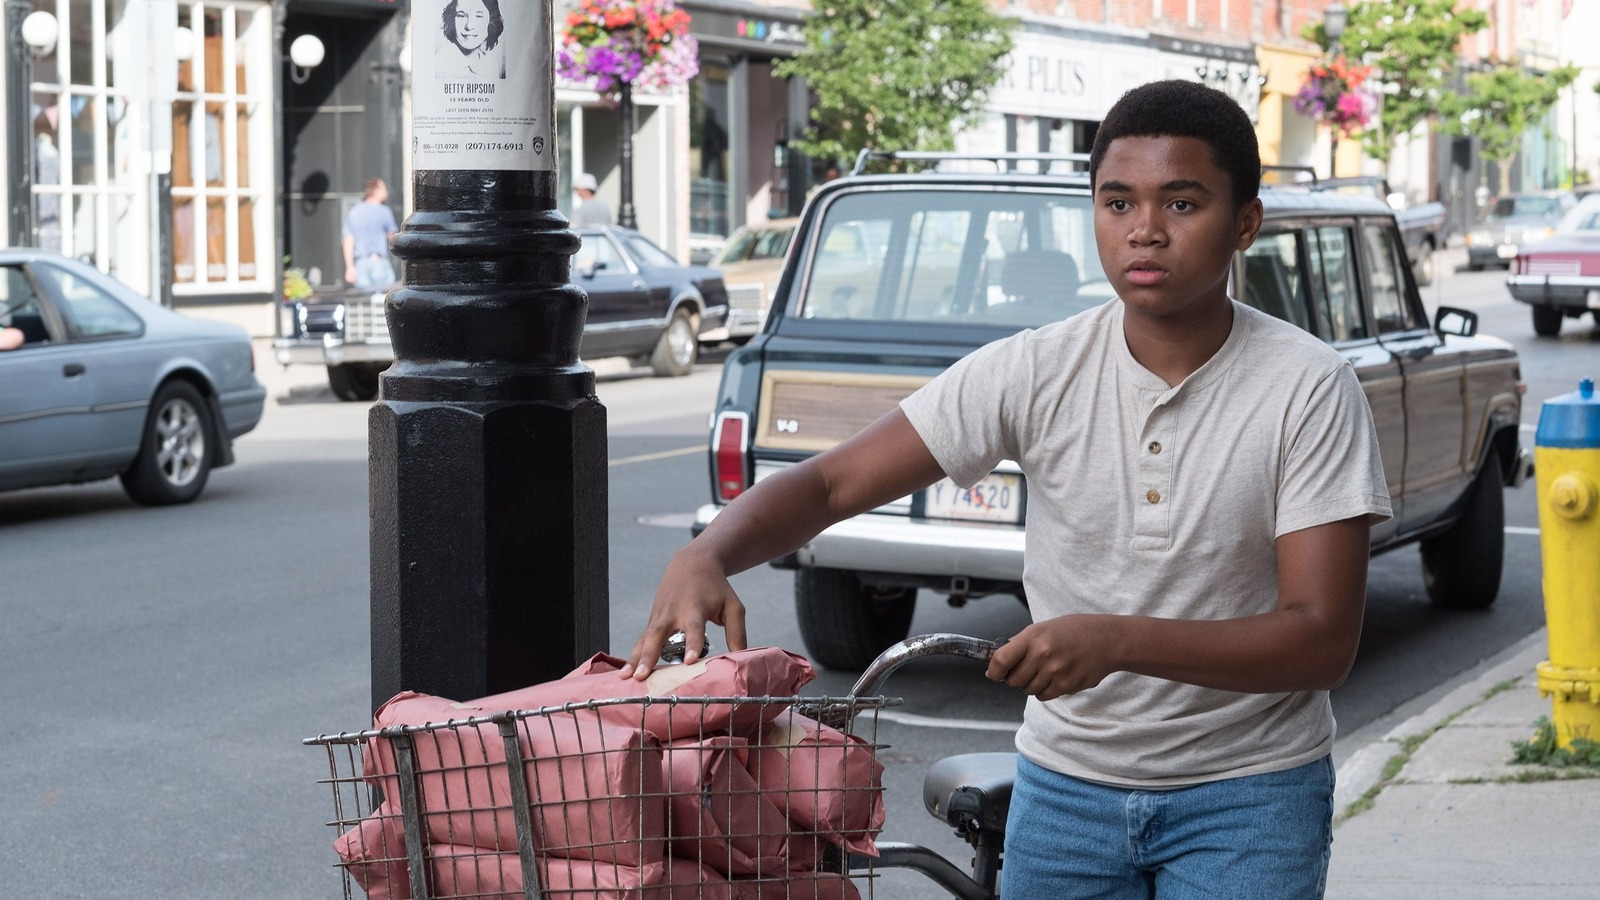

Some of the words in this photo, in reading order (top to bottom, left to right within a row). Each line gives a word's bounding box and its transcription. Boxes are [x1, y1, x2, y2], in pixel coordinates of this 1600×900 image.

[1027, 55, 1086, 96] PLUS
[444, 83, 464, 94] BETTY
[466, 83, 495, 94] RIPSOM
[465, 142, 524, 151] (207)174-6913
[952, 484, 1010, 510] 74520
